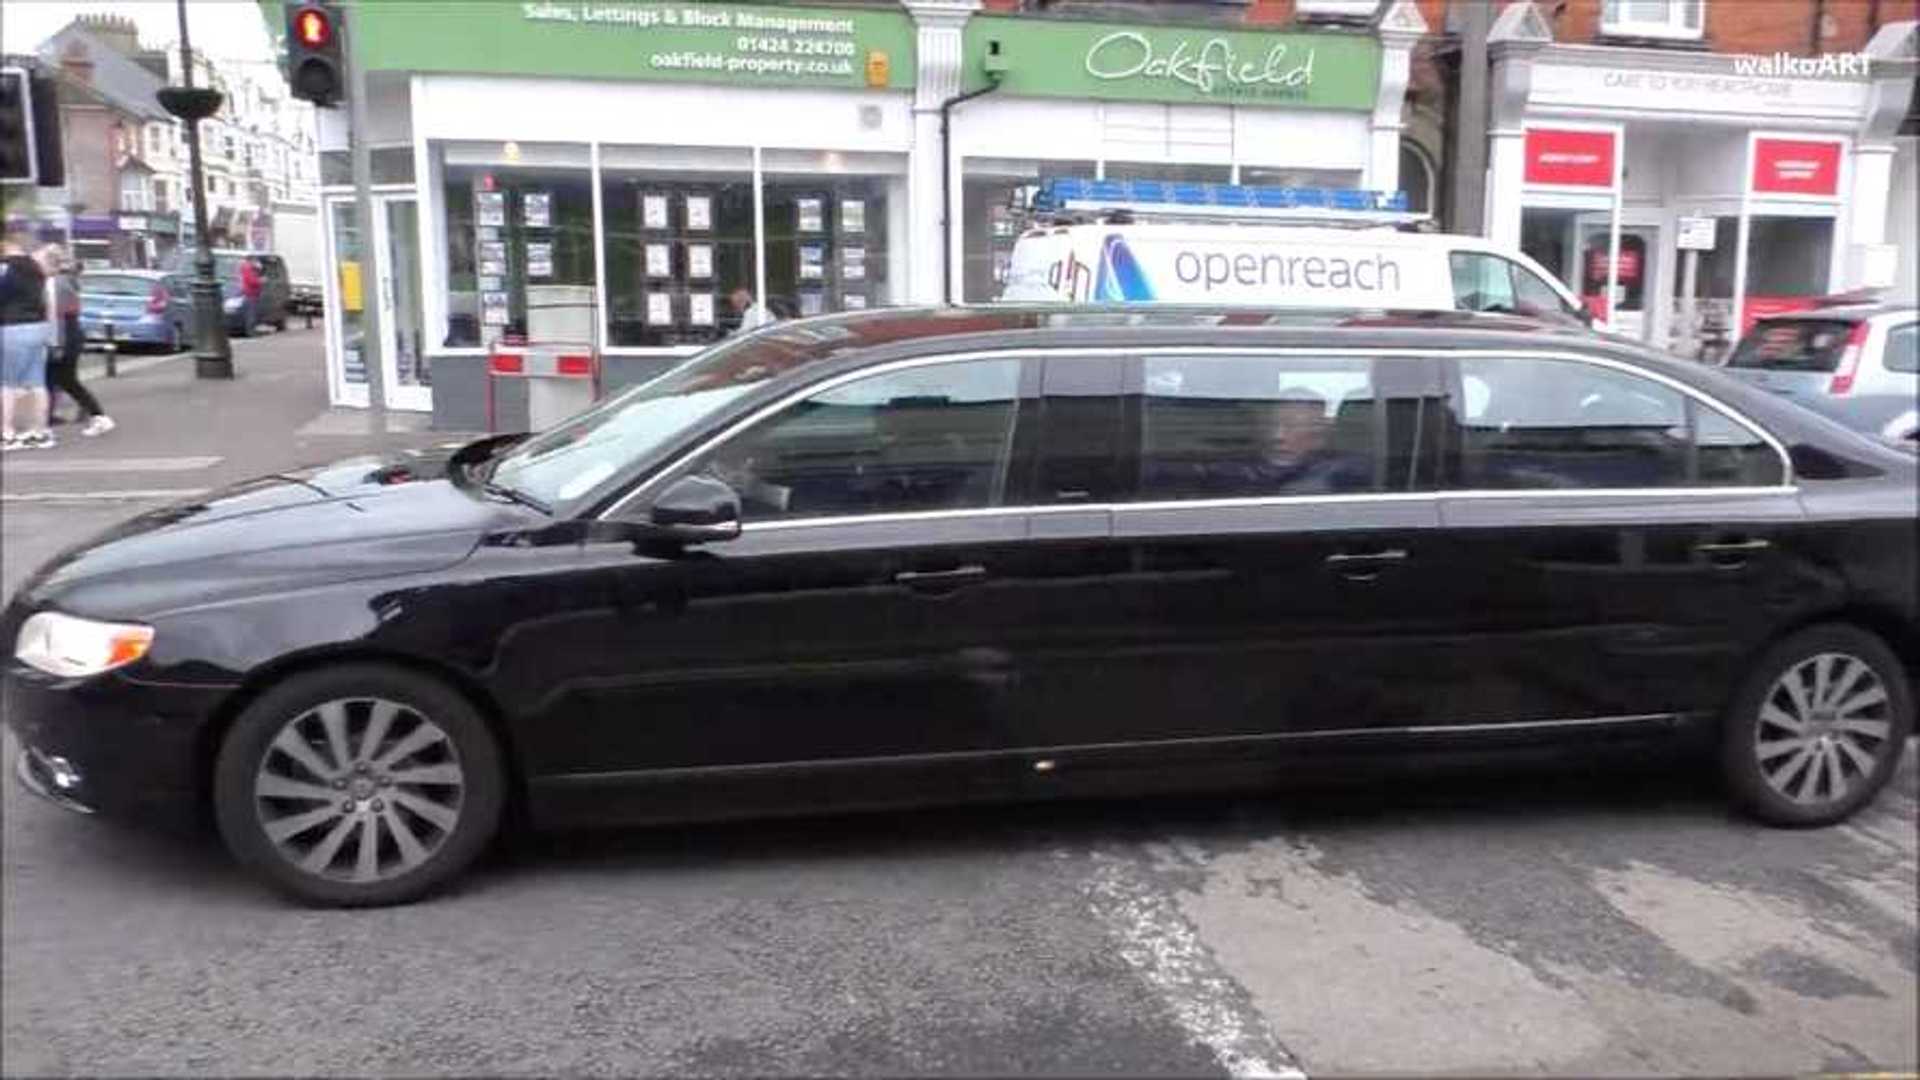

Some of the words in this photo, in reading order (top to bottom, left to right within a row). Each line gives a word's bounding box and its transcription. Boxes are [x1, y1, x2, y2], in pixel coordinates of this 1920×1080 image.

[523, 2, 576, 22] Sales,
[583, 6, 659, 28] Lettings
[665, 9, 676, 24] &
[683, 11, 729, 27] Block
[737, 15, 853, 33] Management
[1086, 33, 1315, 91] Oakfield
[1174, 250, 1400, 290] openreach
